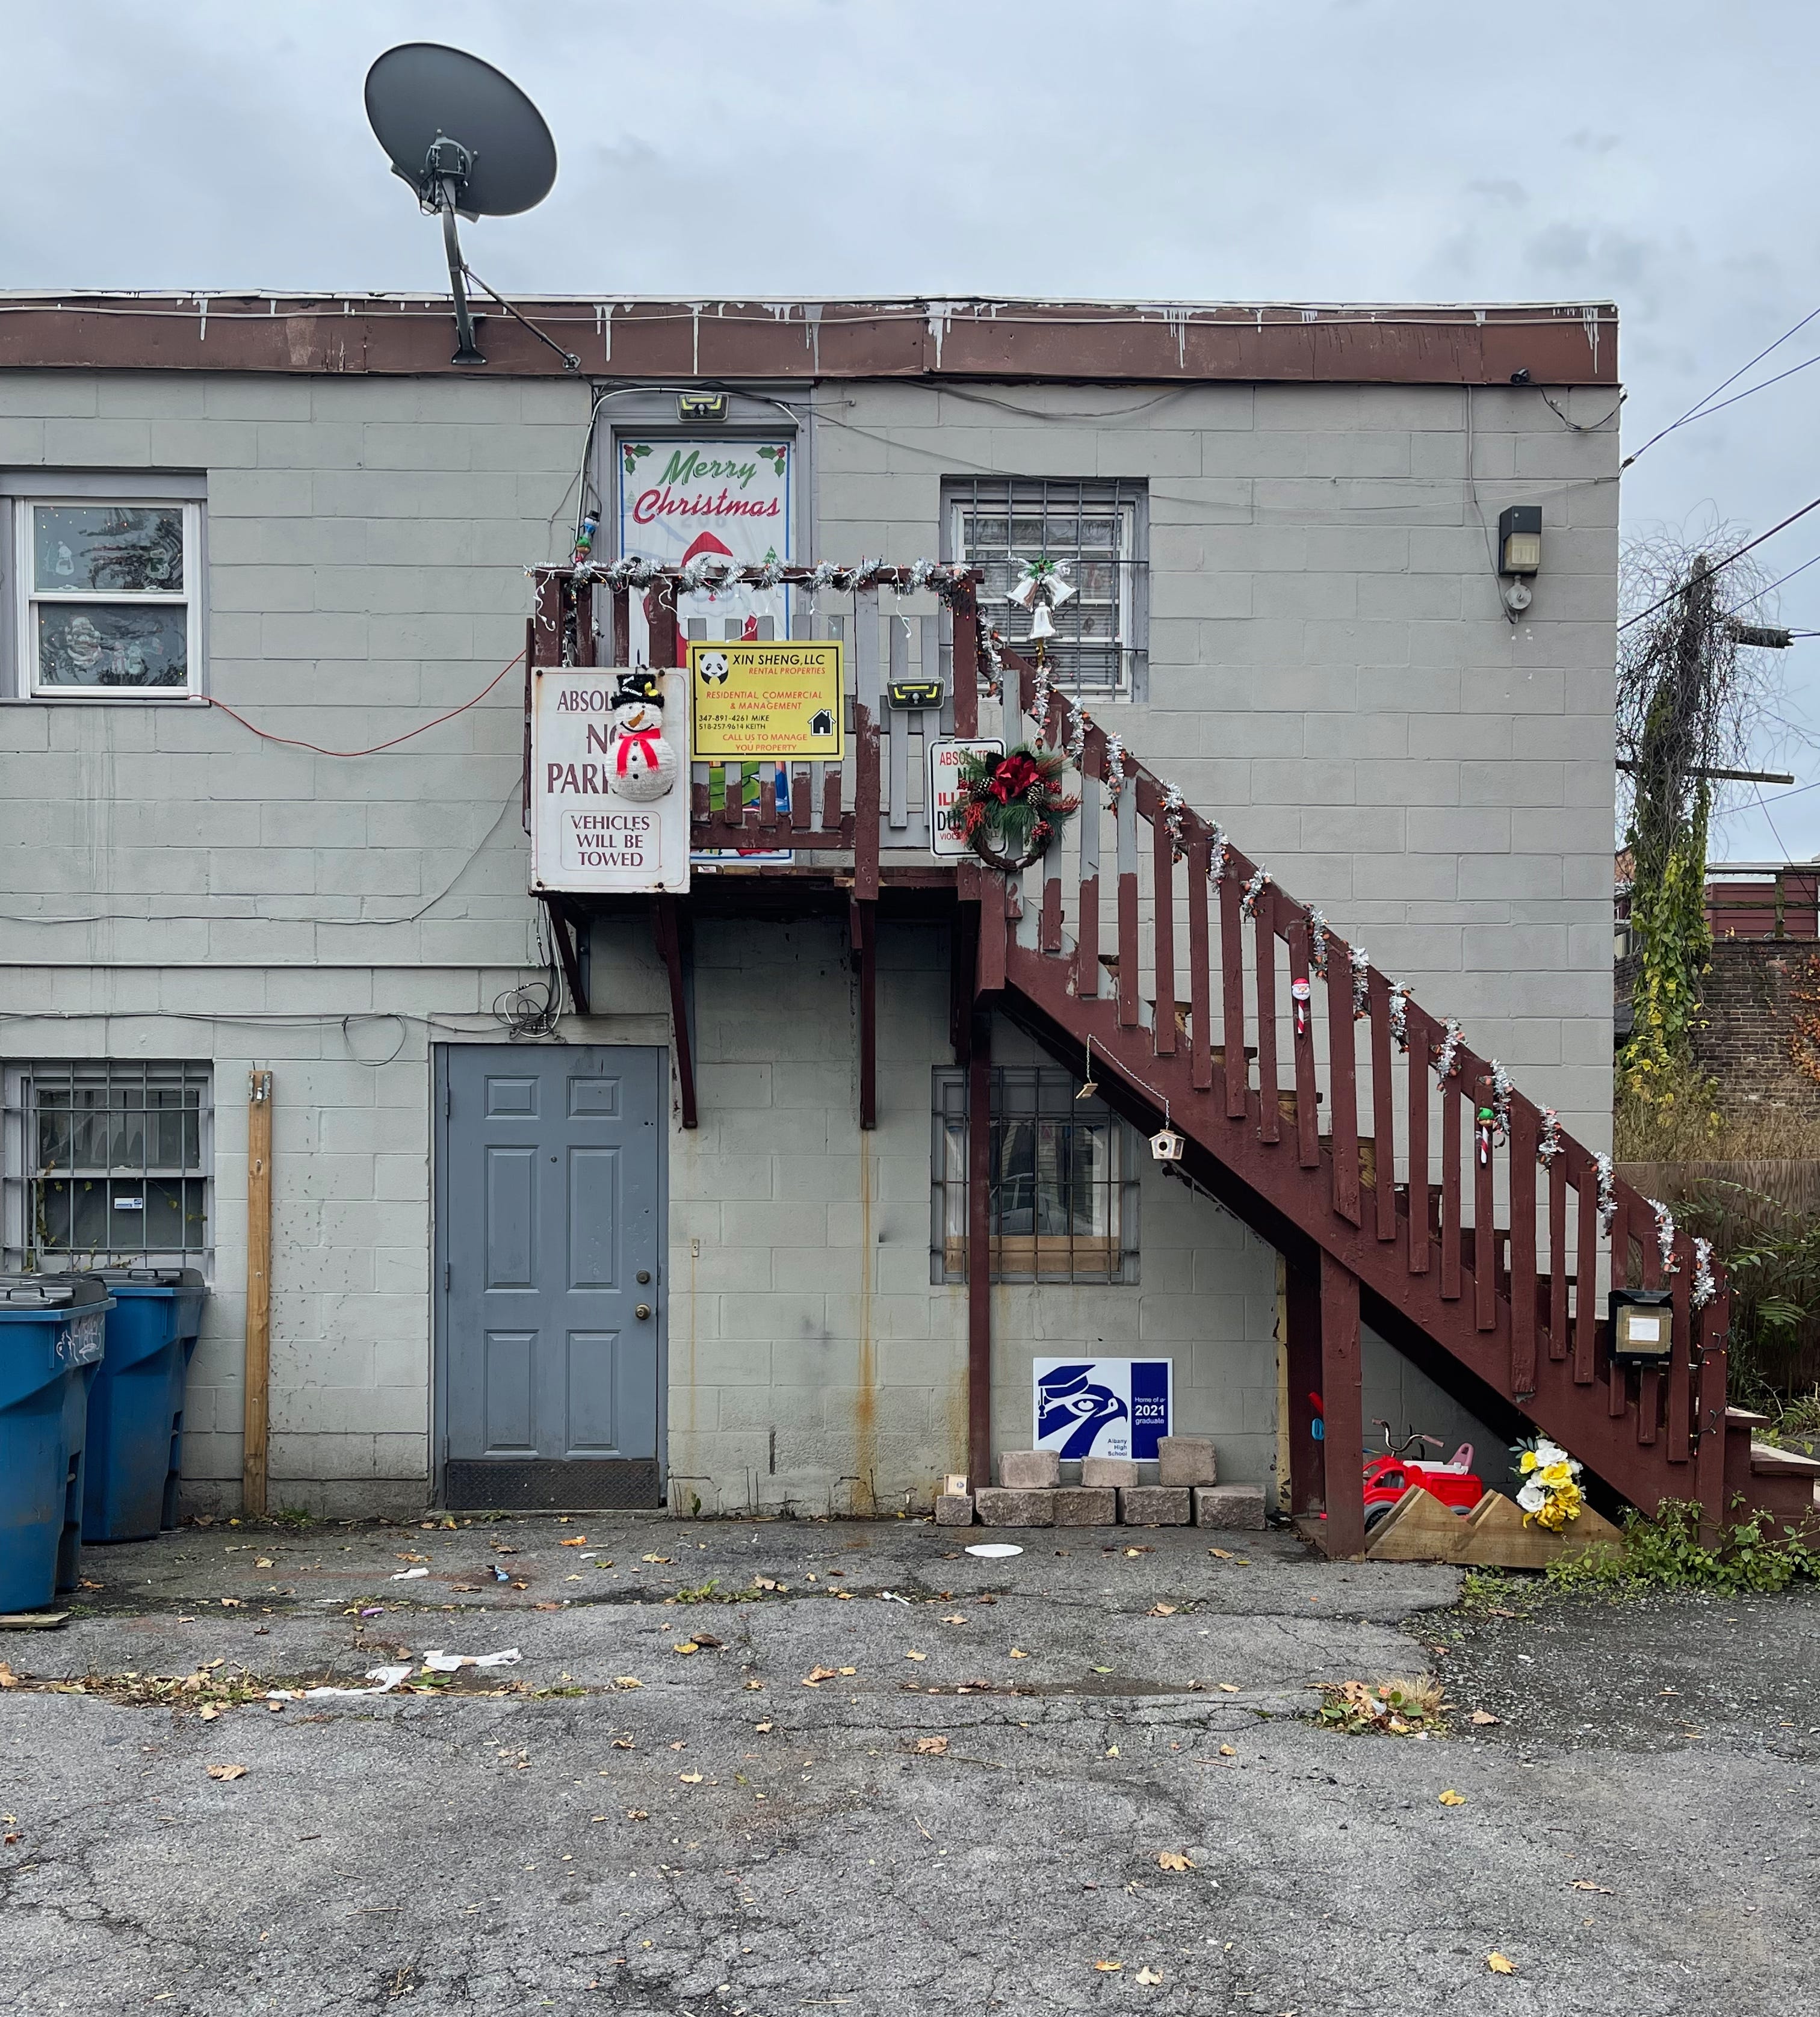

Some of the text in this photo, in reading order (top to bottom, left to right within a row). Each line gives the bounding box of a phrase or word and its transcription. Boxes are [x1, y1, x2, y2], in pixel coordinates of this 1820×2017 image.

[655, 449, 757, 490] Merry
[633, 486, 781, 524] Christmas
[732, 654, 825, 666] XIN SHENG,LLC
[763, 691, 822, 699] COMMERCIAL
[571, 815, 650, 830] VEHICLES
[576, 834, 643, 848] WILL BE
[578, 851, 643, 866] TOWED
[1135, 1404, 1165, 1416] 2021
